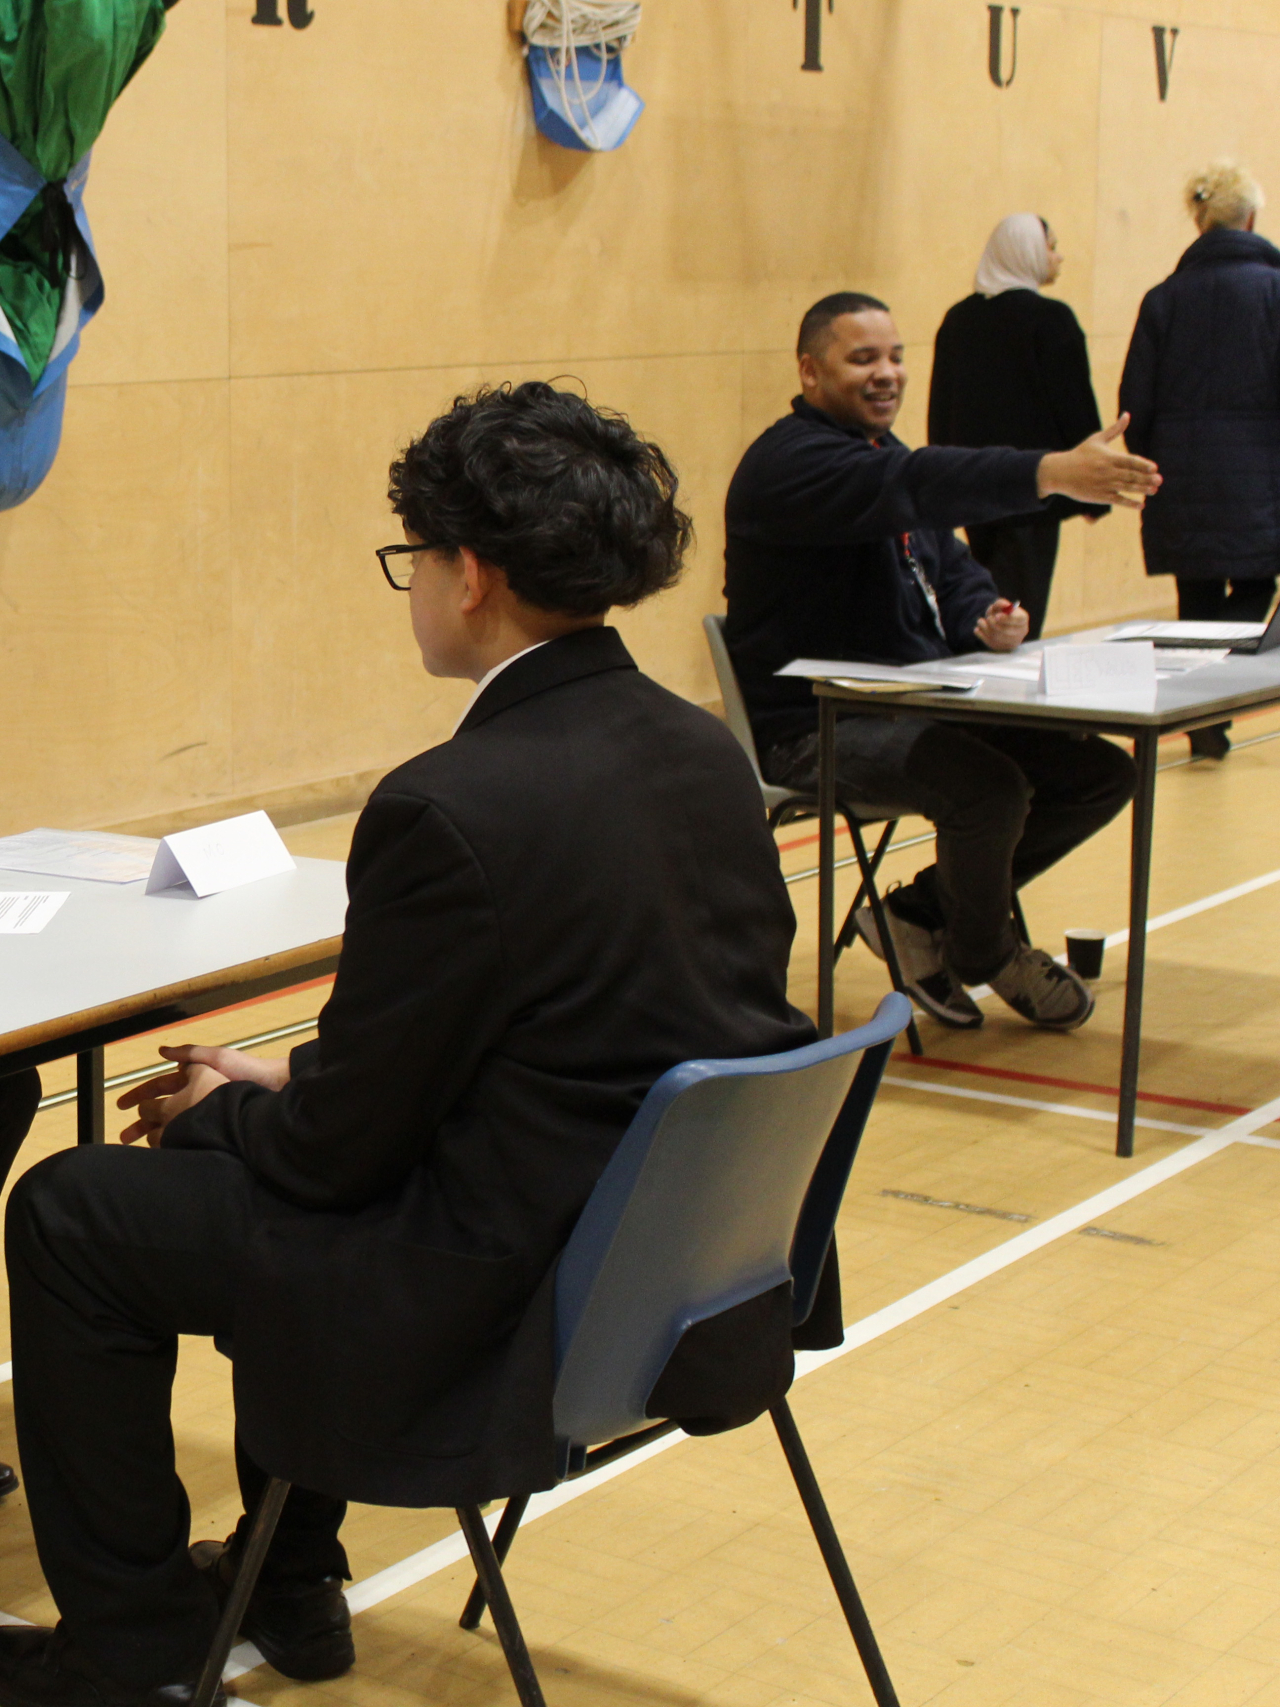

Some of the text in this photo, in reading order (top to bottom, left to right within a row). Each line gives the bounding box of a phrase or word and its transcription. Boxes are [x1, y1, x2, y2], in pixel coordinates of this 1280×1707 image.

[792, 0, 1179, 102] T U V
